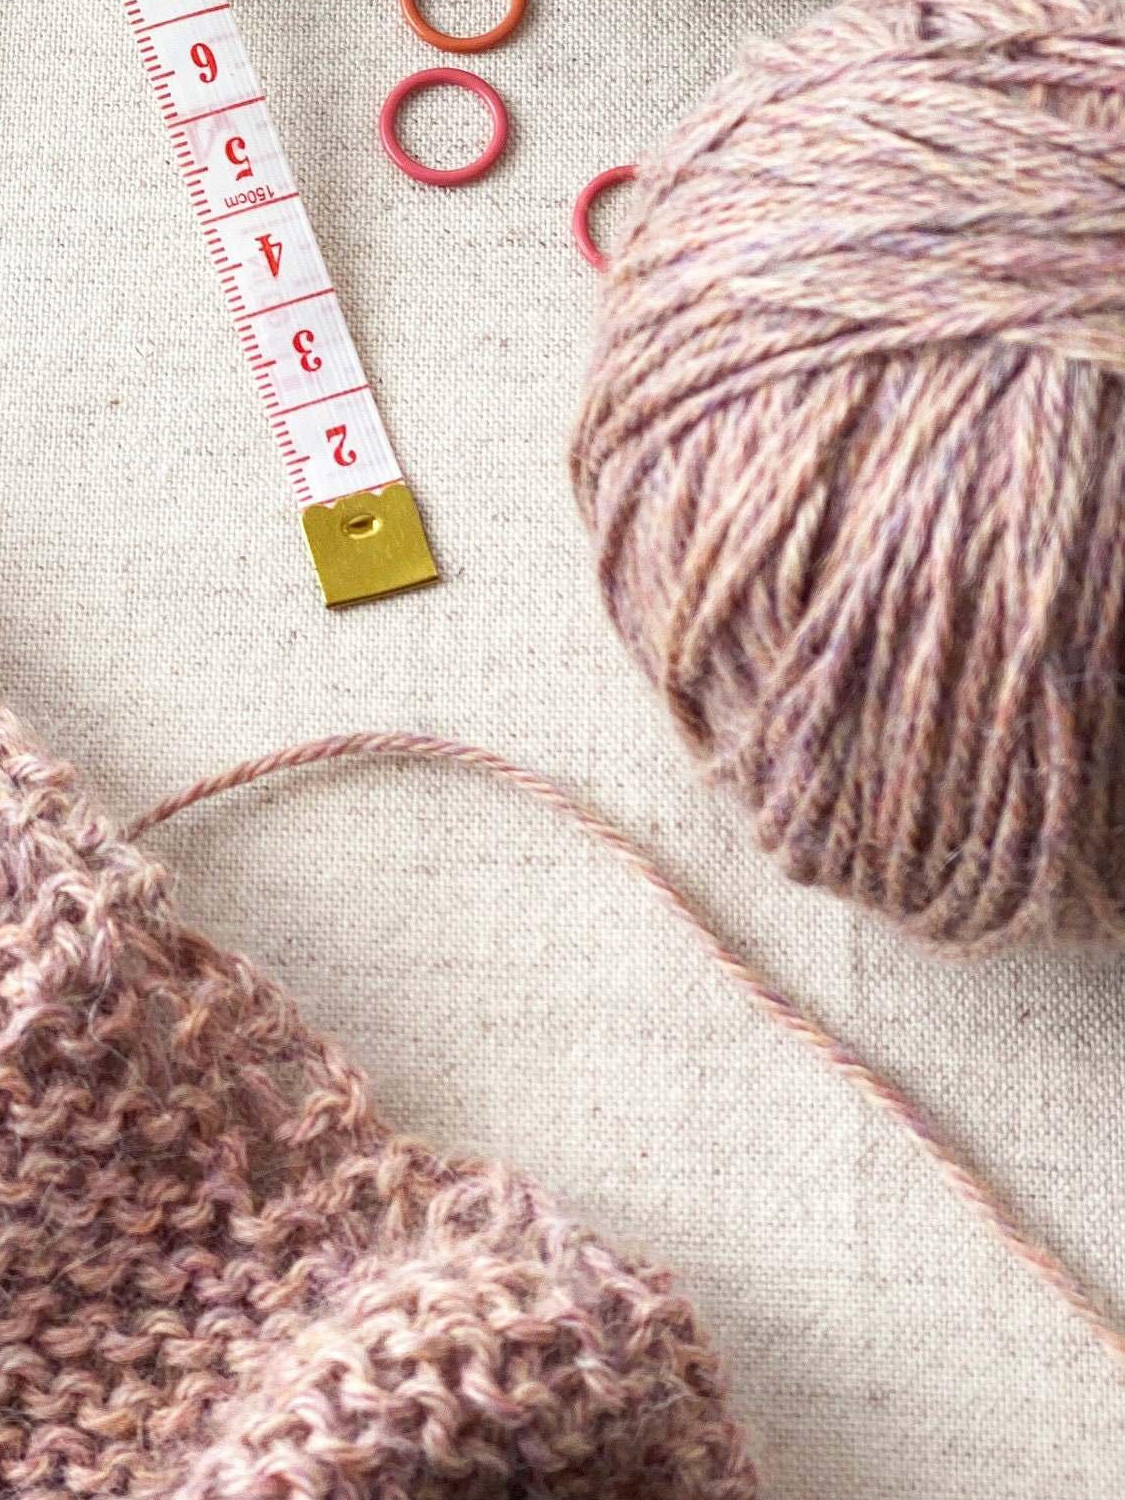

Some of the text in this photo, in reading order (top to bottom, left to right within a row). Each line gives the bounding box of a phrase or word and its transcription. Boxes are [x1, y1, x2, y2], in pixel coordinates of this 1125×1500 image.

[190, 42, 218, 83] 6
[225, 136, 254, 181] 5
[224, 185, 275, 209] 150cm
[255, 232, 284, 278] 4
[292, 329, 322, 372] 3
[325, 424, 357, 467] 2
